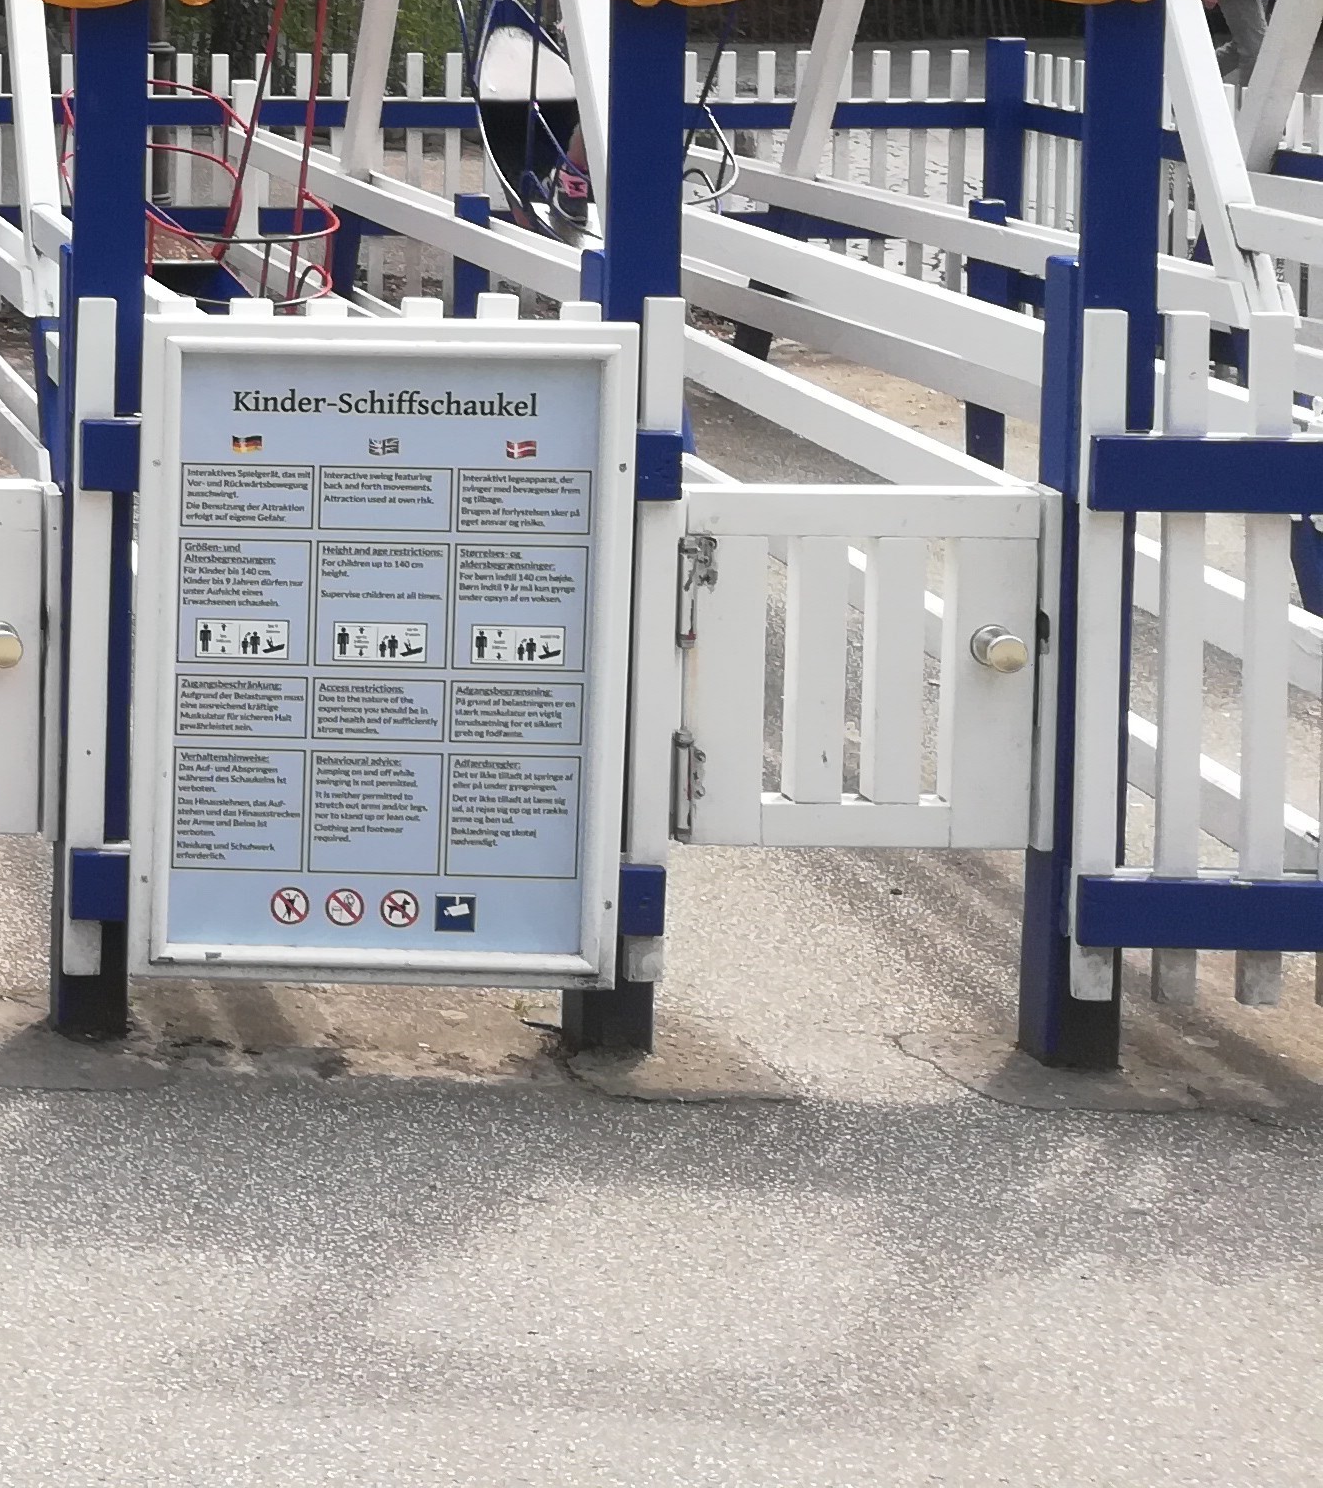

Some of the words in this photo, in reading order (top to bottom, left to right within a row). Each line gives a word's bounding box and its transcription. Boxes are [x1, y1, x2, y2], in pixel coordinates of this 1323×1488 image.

[232, 389, 538, 417] Kinder-Schiffschaukel
[323, 546, 352, 555] Height
[355, 547, 370, 555] and
[321, 591, 360, 599] Supervise
[362, 591, 395, 599] children
[319, 684, 349, 692] Access
